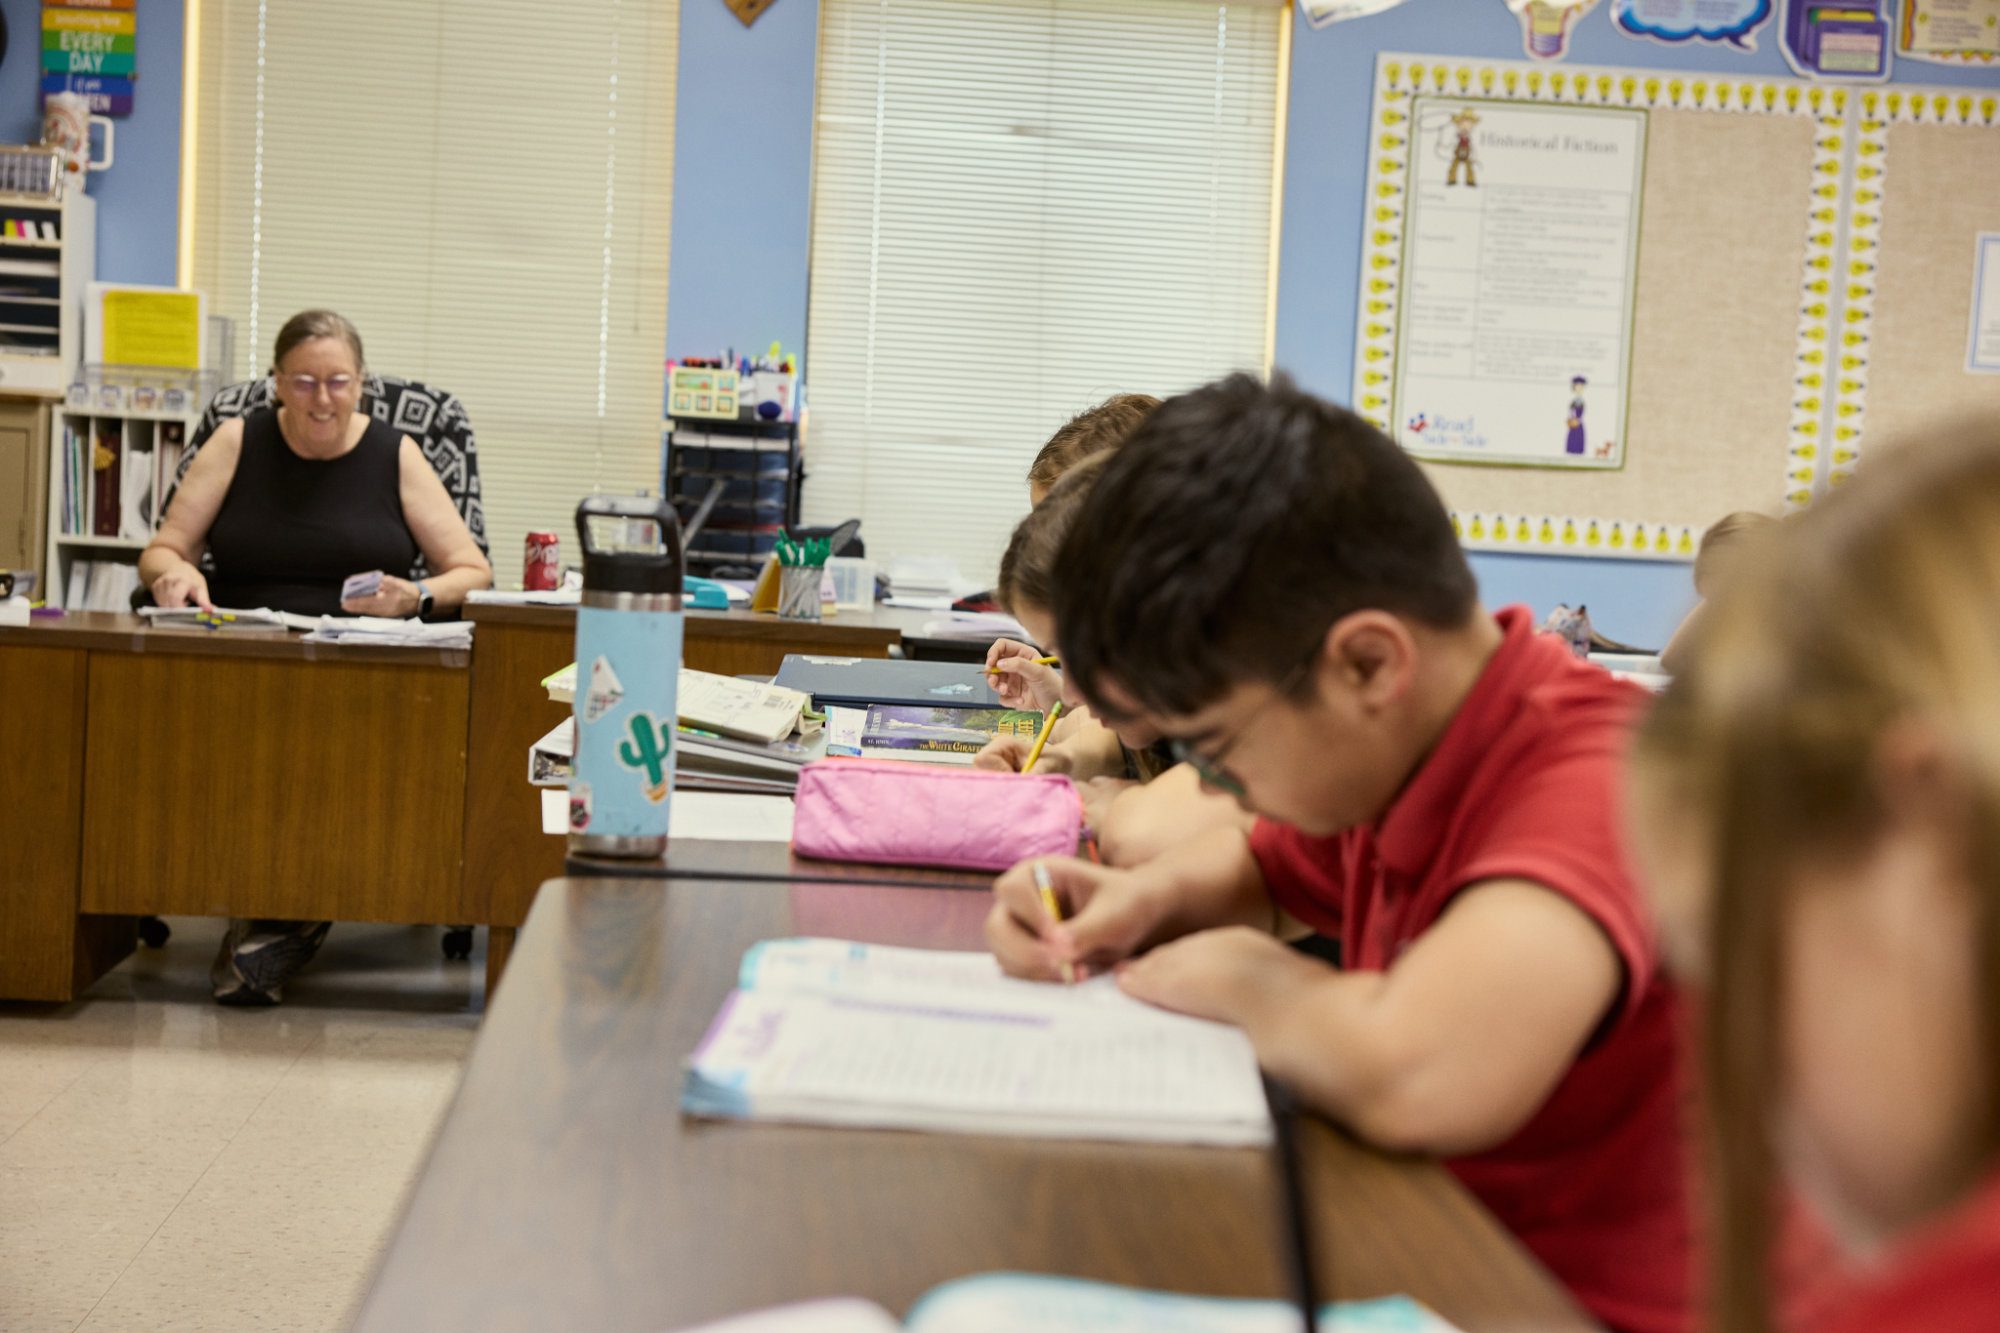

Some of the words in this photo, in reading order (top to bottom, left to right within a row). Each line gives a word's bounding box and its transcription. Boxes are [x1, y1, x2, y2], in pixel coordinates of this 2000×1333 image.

[60, 30, 115, 53] EVERY
[69, 50, 105, 73] DAY
[1479, 130, 1560, 150] Historical
[1562, 135, 1619, 154] Fiction
[928, 739, 952, 751] WHITE
